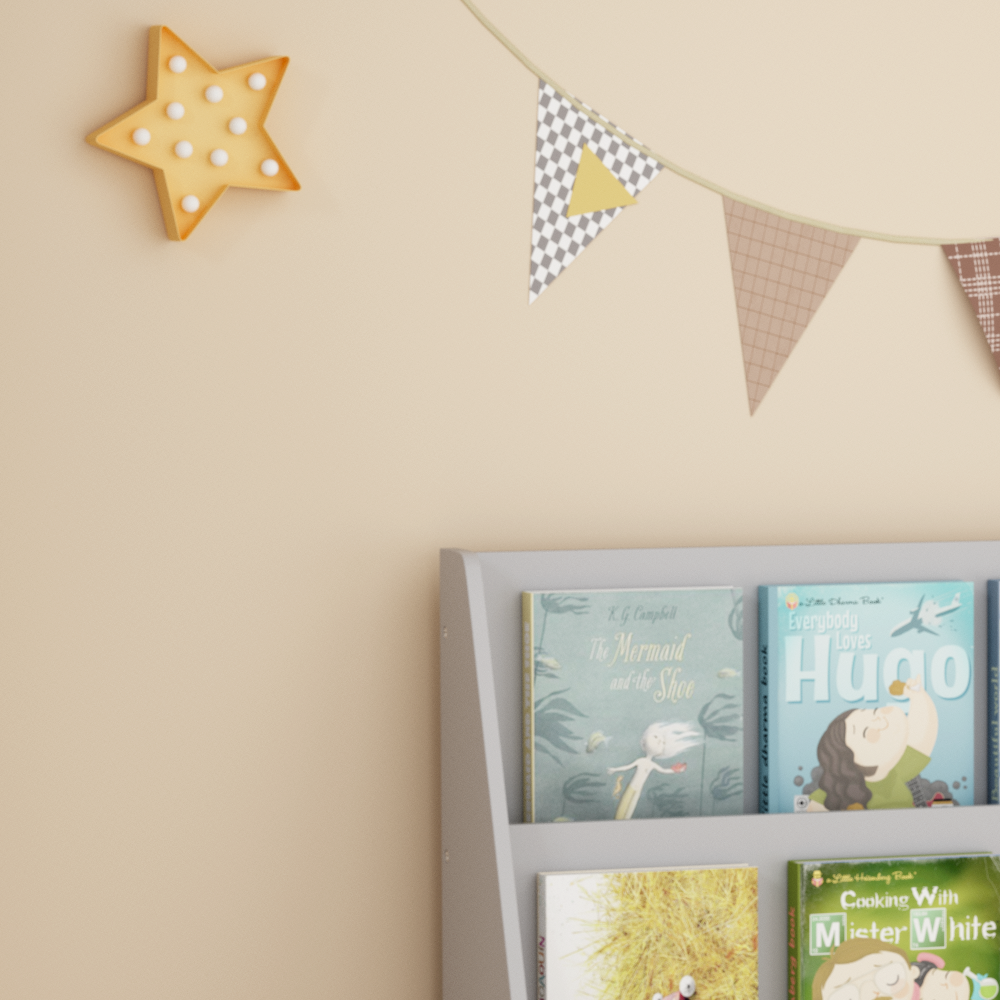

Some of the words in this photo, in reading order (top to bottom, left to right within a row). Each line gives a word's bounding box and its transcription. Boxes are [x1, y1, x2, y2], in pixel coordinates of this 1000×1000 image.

[633, 604, 678, 624] Campbell
[788, 610, 858, 633] Everybody
[589, 638, 609, 662] The
[608, 632, 692, 667] Mermaid
[835, 632, 872, 650] Loves
[610, 669, 635, 690] and
[633, 668, 656, 690] the
[653, 667, 695, 704] Shoe
[785, 635, 972, 716] Hugo
[840, 889, 910, 911] Cooking
[911, 886, 959, 907] With
[912, 914, 998, 943] White
